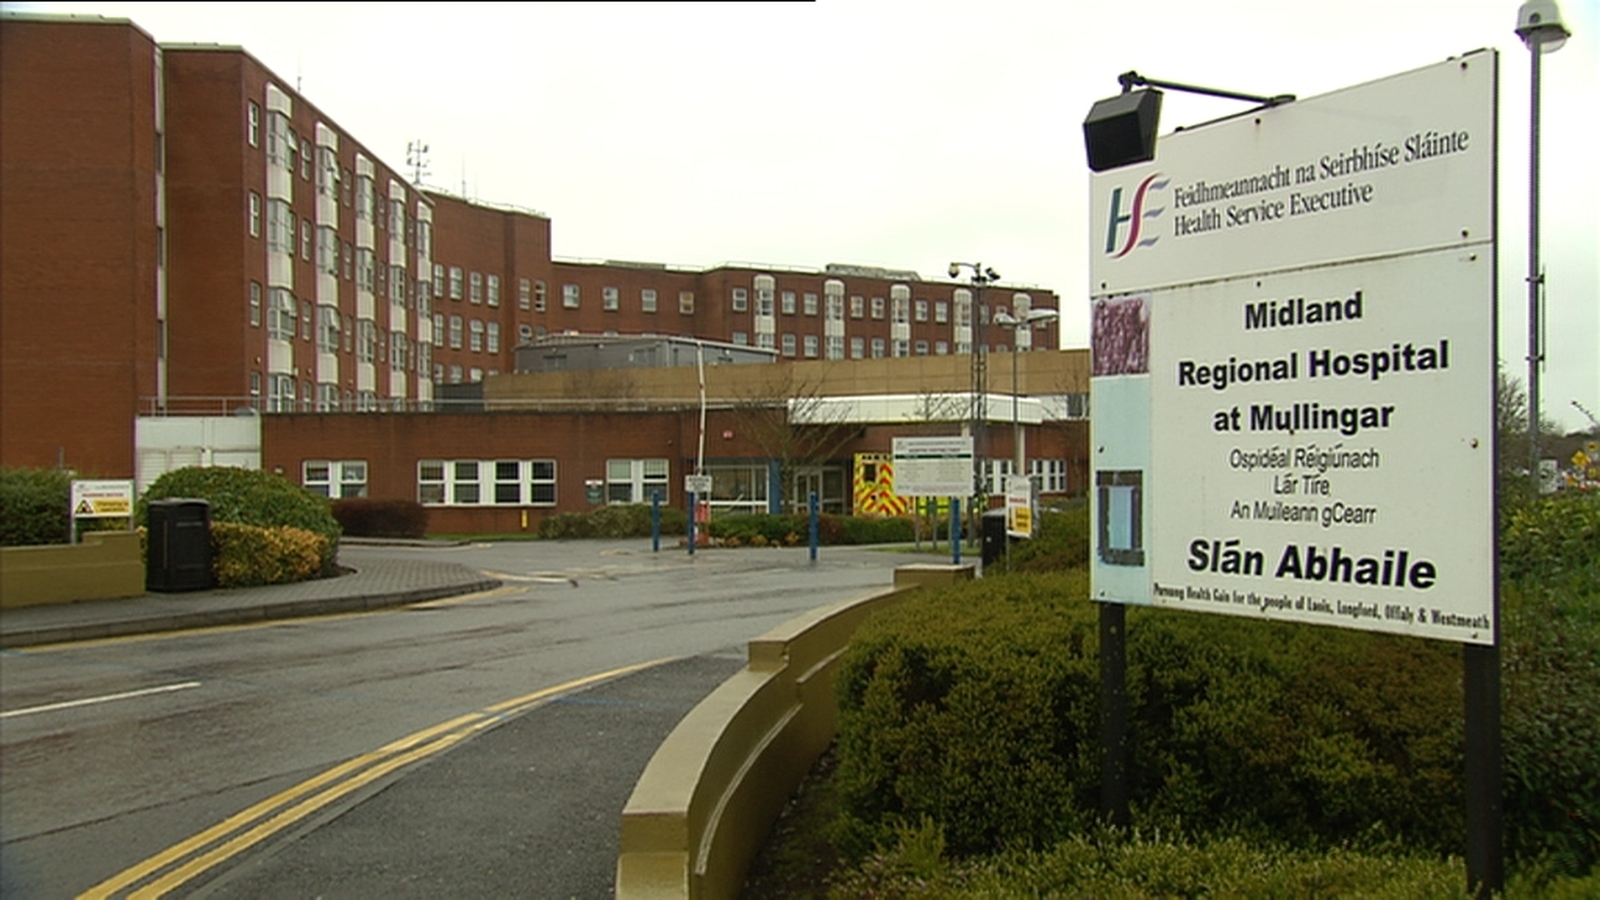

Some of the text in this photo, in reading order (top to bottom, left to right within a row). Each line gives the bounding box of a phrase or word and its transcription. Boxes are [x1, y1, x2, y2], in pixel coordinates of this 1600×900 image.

[1174, 129, 1470, 209] Feidhmeannacht na Seirbhíse Sláinte
[1174, 182, 1373, 237] Health Service Executive
[1245, 291, 1363, 330] Midland
[1178, 340, 1449, 390] Regional Hospital
[1214, 403, 1395, 435] at Mullingar
[1230, 443, 1379, 473] Ospidéal Réigiúnach
[1274, 473, 1298, 495] Lár
[1231, 500, 1377, 527] An Muileann gCearr
[1188, 539, 1437, 589] Slán Abhaile
[1186, 586, 1211, 600] Health
[1213, 588, 1230, 602] Gain
[1233, 590, 1245, 602] for
[1247, 592, 1261, 605] the
[1264, 595, 1292, 609] people
[1295, 596, 1305, 610] of
[1384, 604, 1414, 623] Offaly
[1417, 607, 1427, 623] &
[1431, 609, 1490, 629] Westmeath
